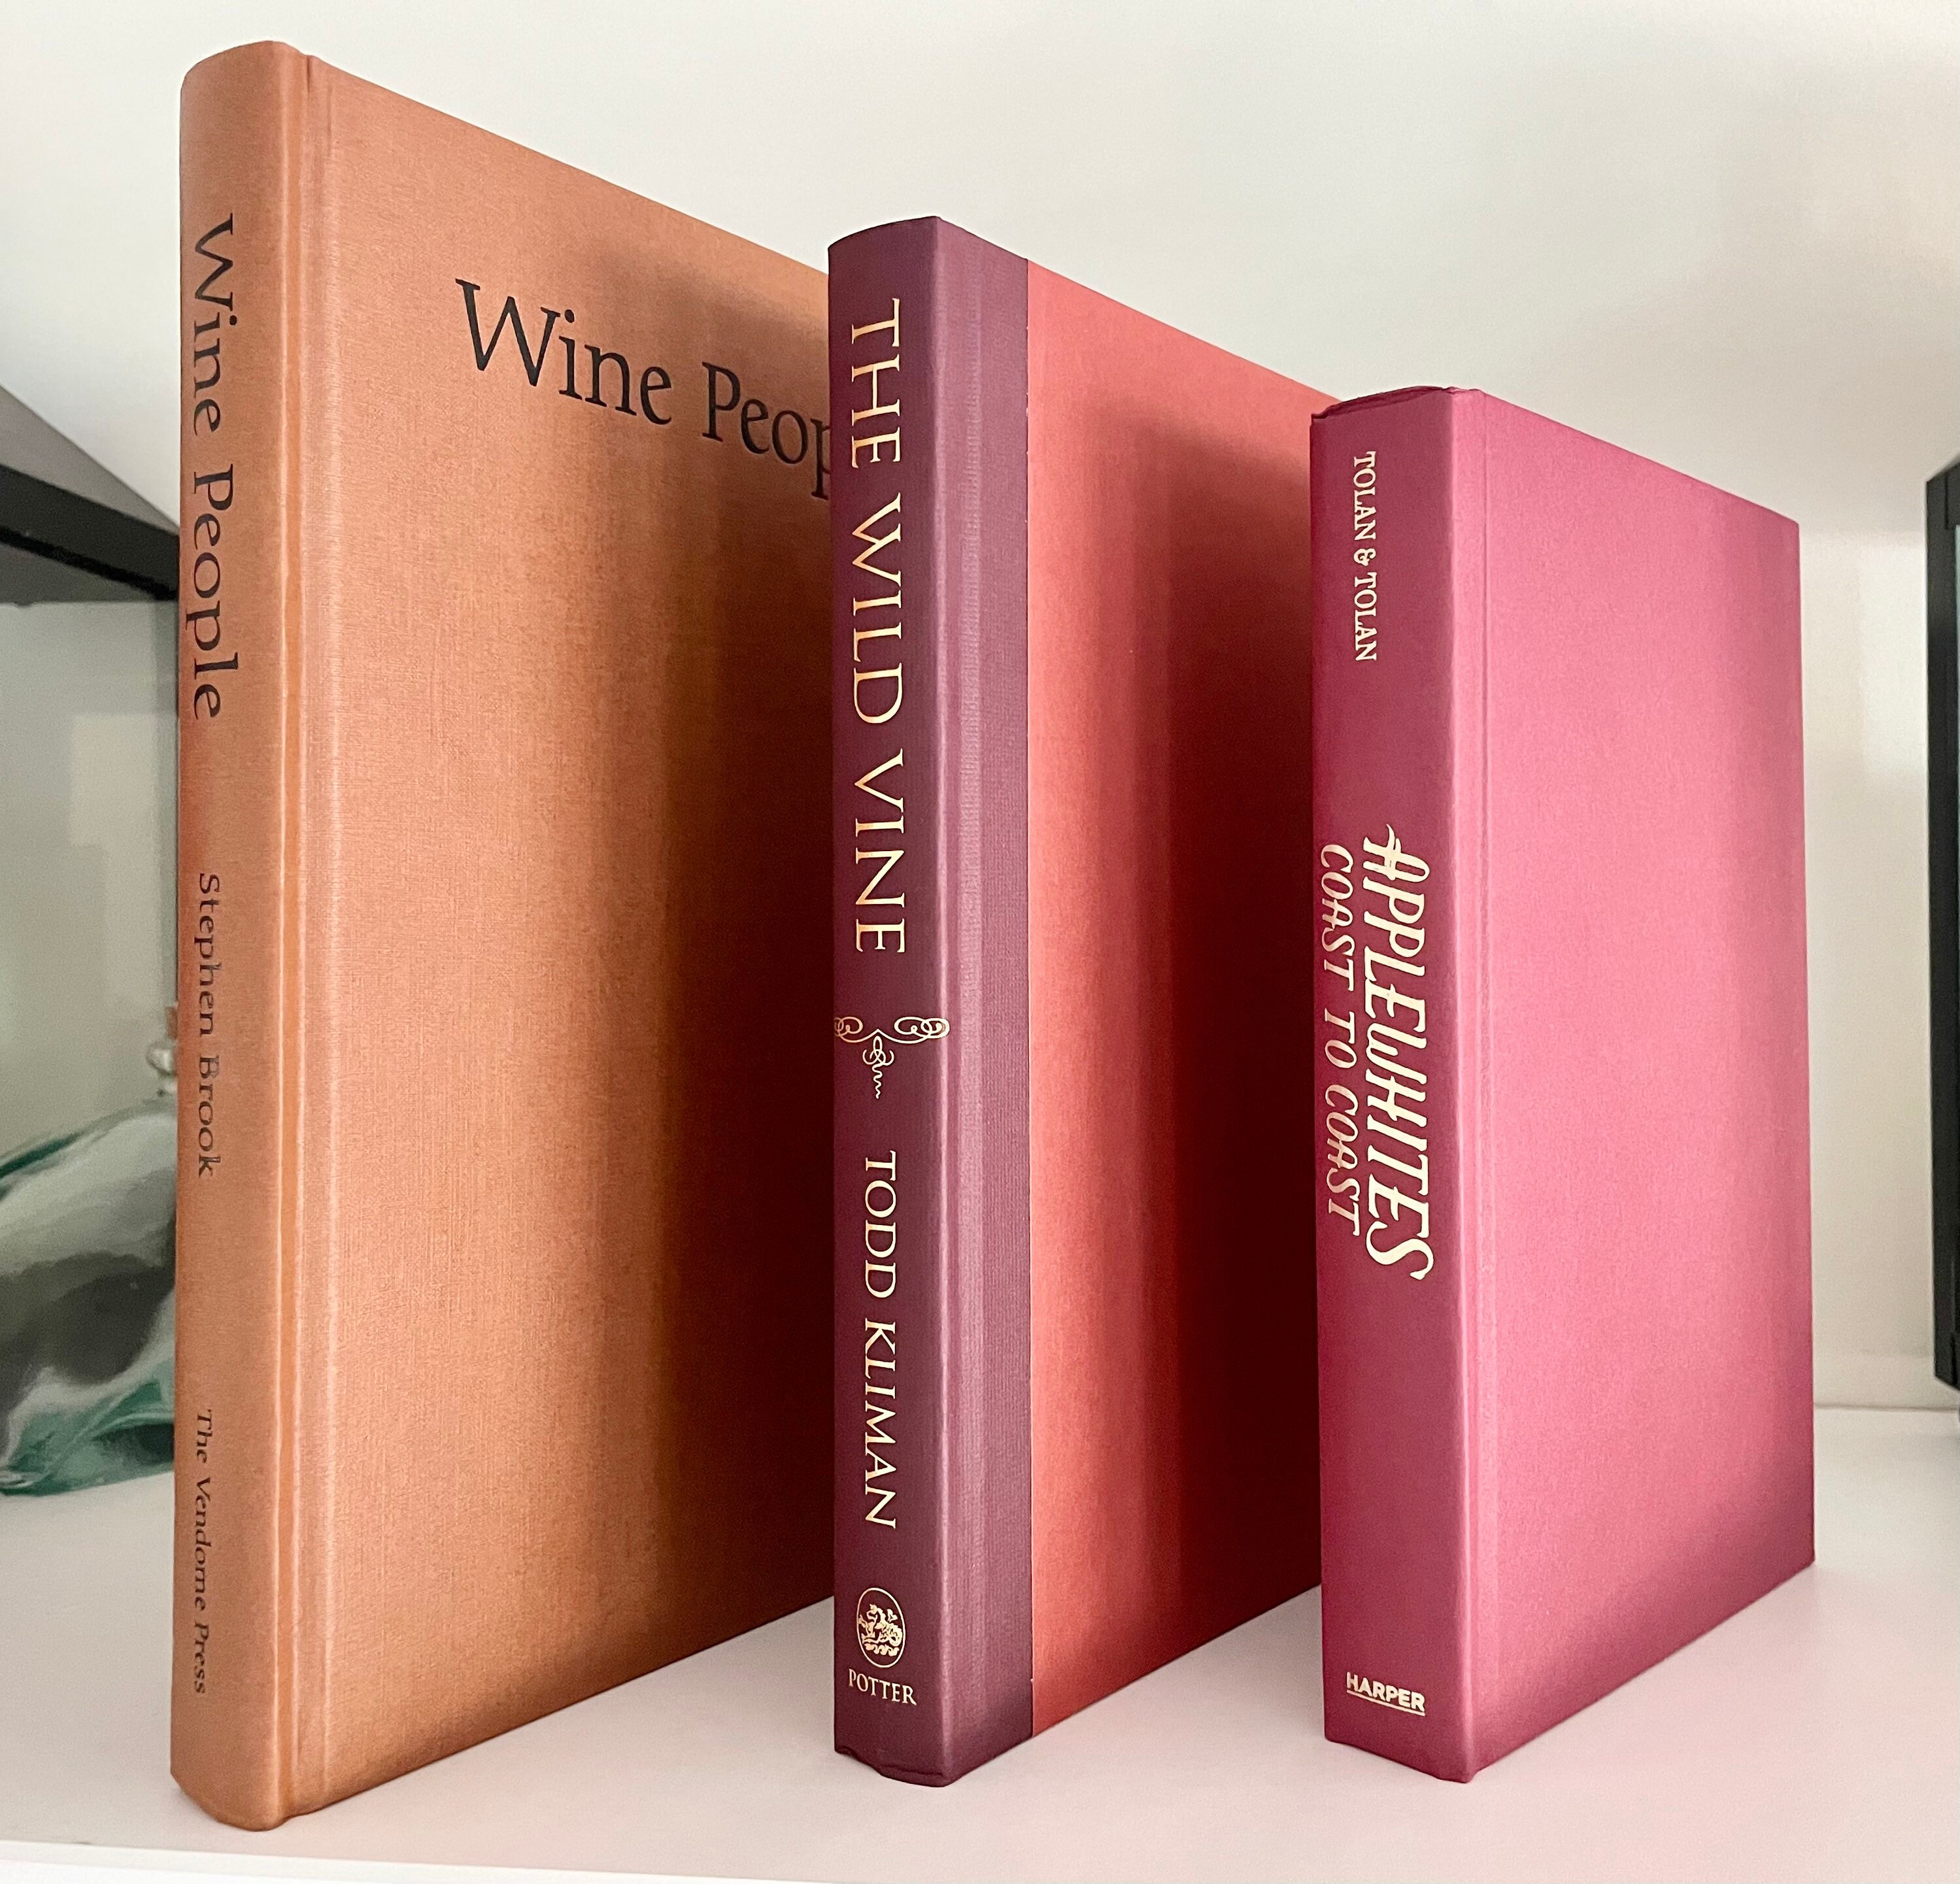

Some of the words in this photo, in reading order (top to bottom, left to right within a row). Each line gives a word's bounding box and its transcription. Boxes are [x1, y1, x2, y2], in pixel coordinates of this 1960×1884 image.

[194, 212, 238, 437] Wine
[455, 278, 671, 425] Wine
[851, 298, 900, 469] THE
[1353, 450, 1376, 541] TOLAN
[1353, 548, 1376, 566] &
[186, 464, 239, 720] People
[852, 492, 902, 724] WILD
[1354, 572, 1377, 661] TOLAN
[854, 748, 905, 954] VINE
[1321, 844, 1354, 991] COAST
[194, 873, 222, 1037] Stephen
[1325, 1008, 1358, 1069] TO
[1362, 824, 1434, 1281] APPLEWHITES
[198, 1055, 221, 1177] Brook
[1325, 1084, 1360, 1236] COAST
[864, 1150, 896, 1299] TODD
[196, 1409, 212, 1464] The
[864, 1318, 896, 1529] KLIMAN
[195, 1476, 212, 1611] Vendome
[194, 1623, 209, 1694] Press
[849, 1668, 917, 1705] POTTER
[1347, 1671, 1425, 1713] HARPER
